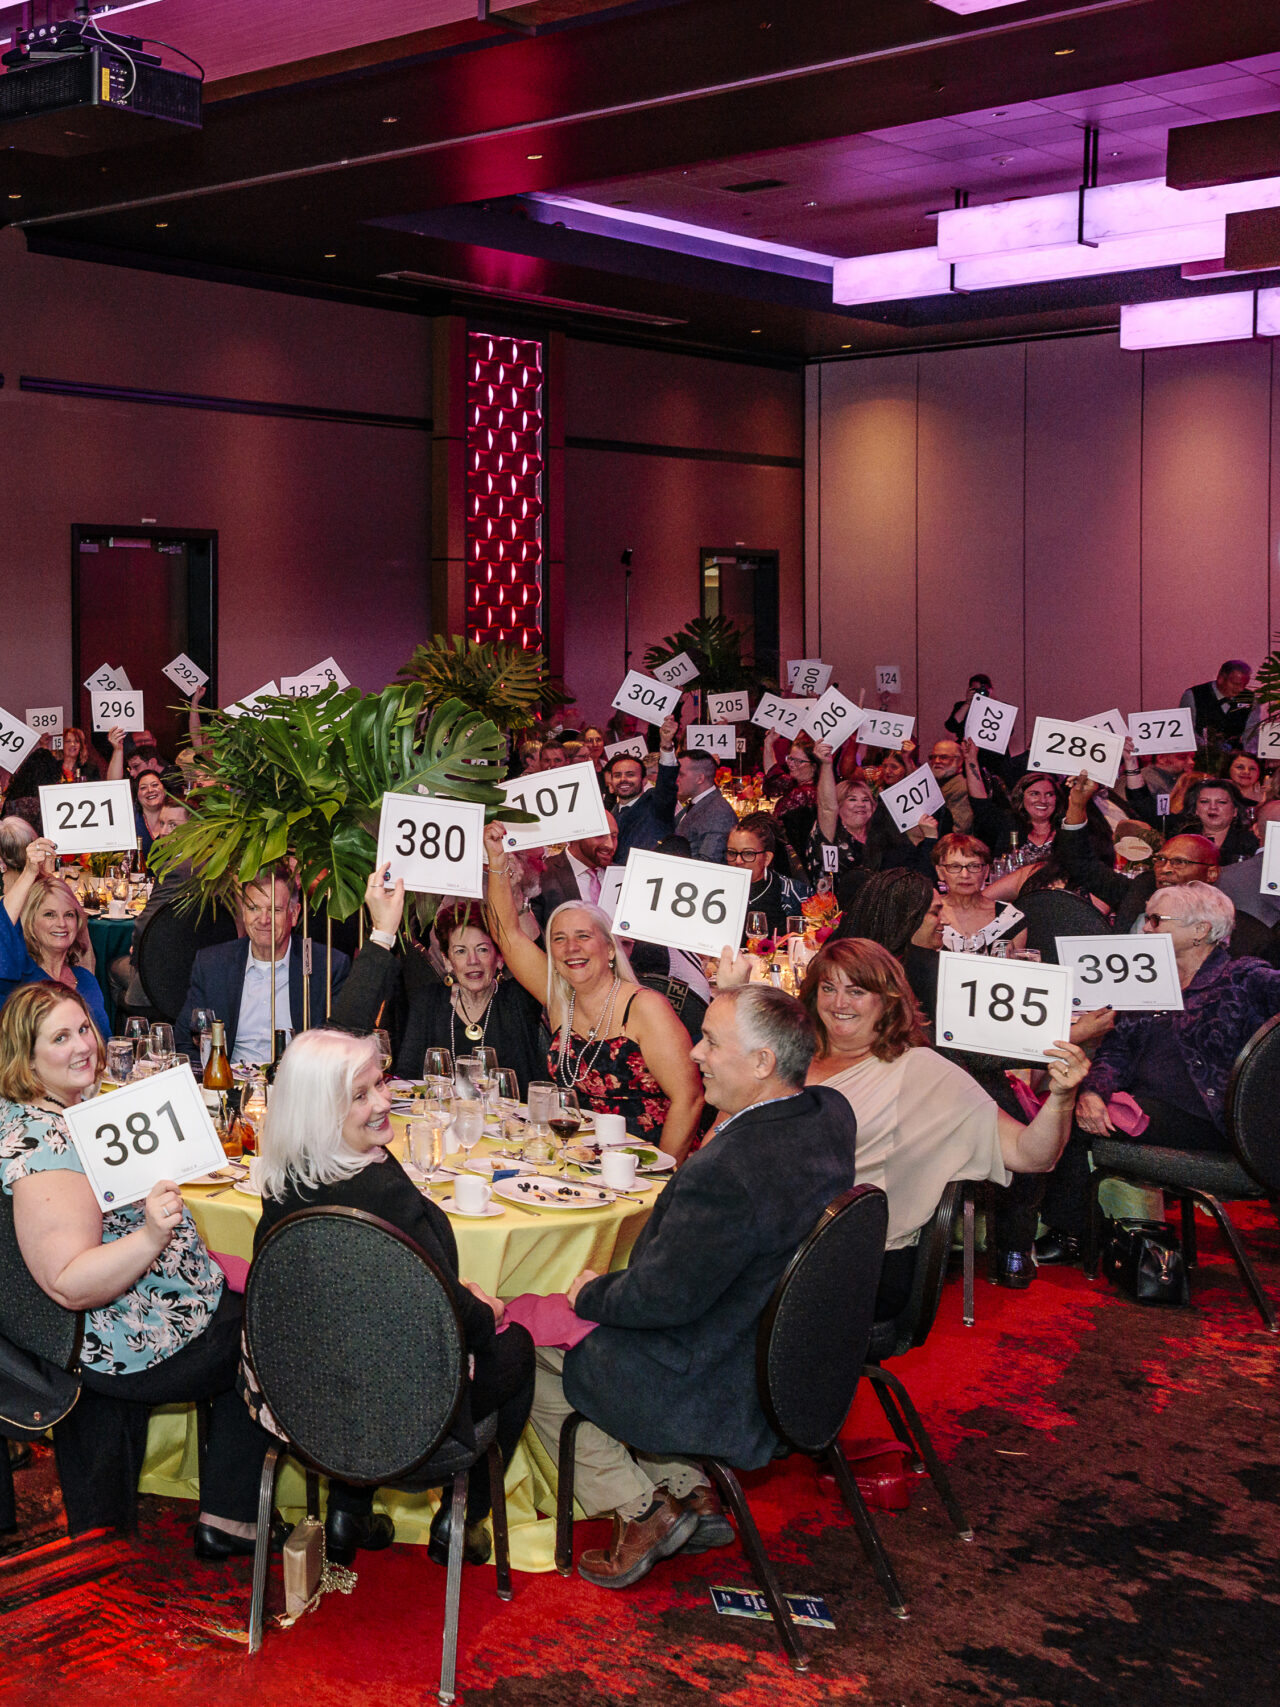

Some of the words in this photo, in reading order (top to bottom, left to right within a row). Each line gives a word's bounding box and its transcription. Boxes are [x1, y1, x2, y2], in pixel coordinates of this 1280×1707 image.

[97, 673, 122, 691] 29
[174, 663, 199, 687] 292
[663, 662, 688, 682] 301
[880, 673, 897, 684] 124
[99, 701, 135, 718] 296
[628, 684, 668, 711] 304
[715, 699, 743, 713] 205
[32, 714, 58, 727] 389
[764, 703, 798, 727] 212
[813, 702, 847, 738] 206
[978, 706, 1003, 742] 283
[695, 733, 728, 747] 214
[870, 719, 904, 738] 135
[1138, 719, 1183, 739] 372
[1046, 732, 1107, 763] 286
[511, 781, 580, 817] 107
[896, 778, 930, 814] 207
[56, 798, 114, 829] 221
[395, 818, 465, 863] 380
[826, 850, 836, 867] 12
[646, 877, 727, 924] 186
[1077, 952, 1158, 984] 393
[960, 979, 1049, 1027] 185
[95, 1100, 185, 1166] 381
